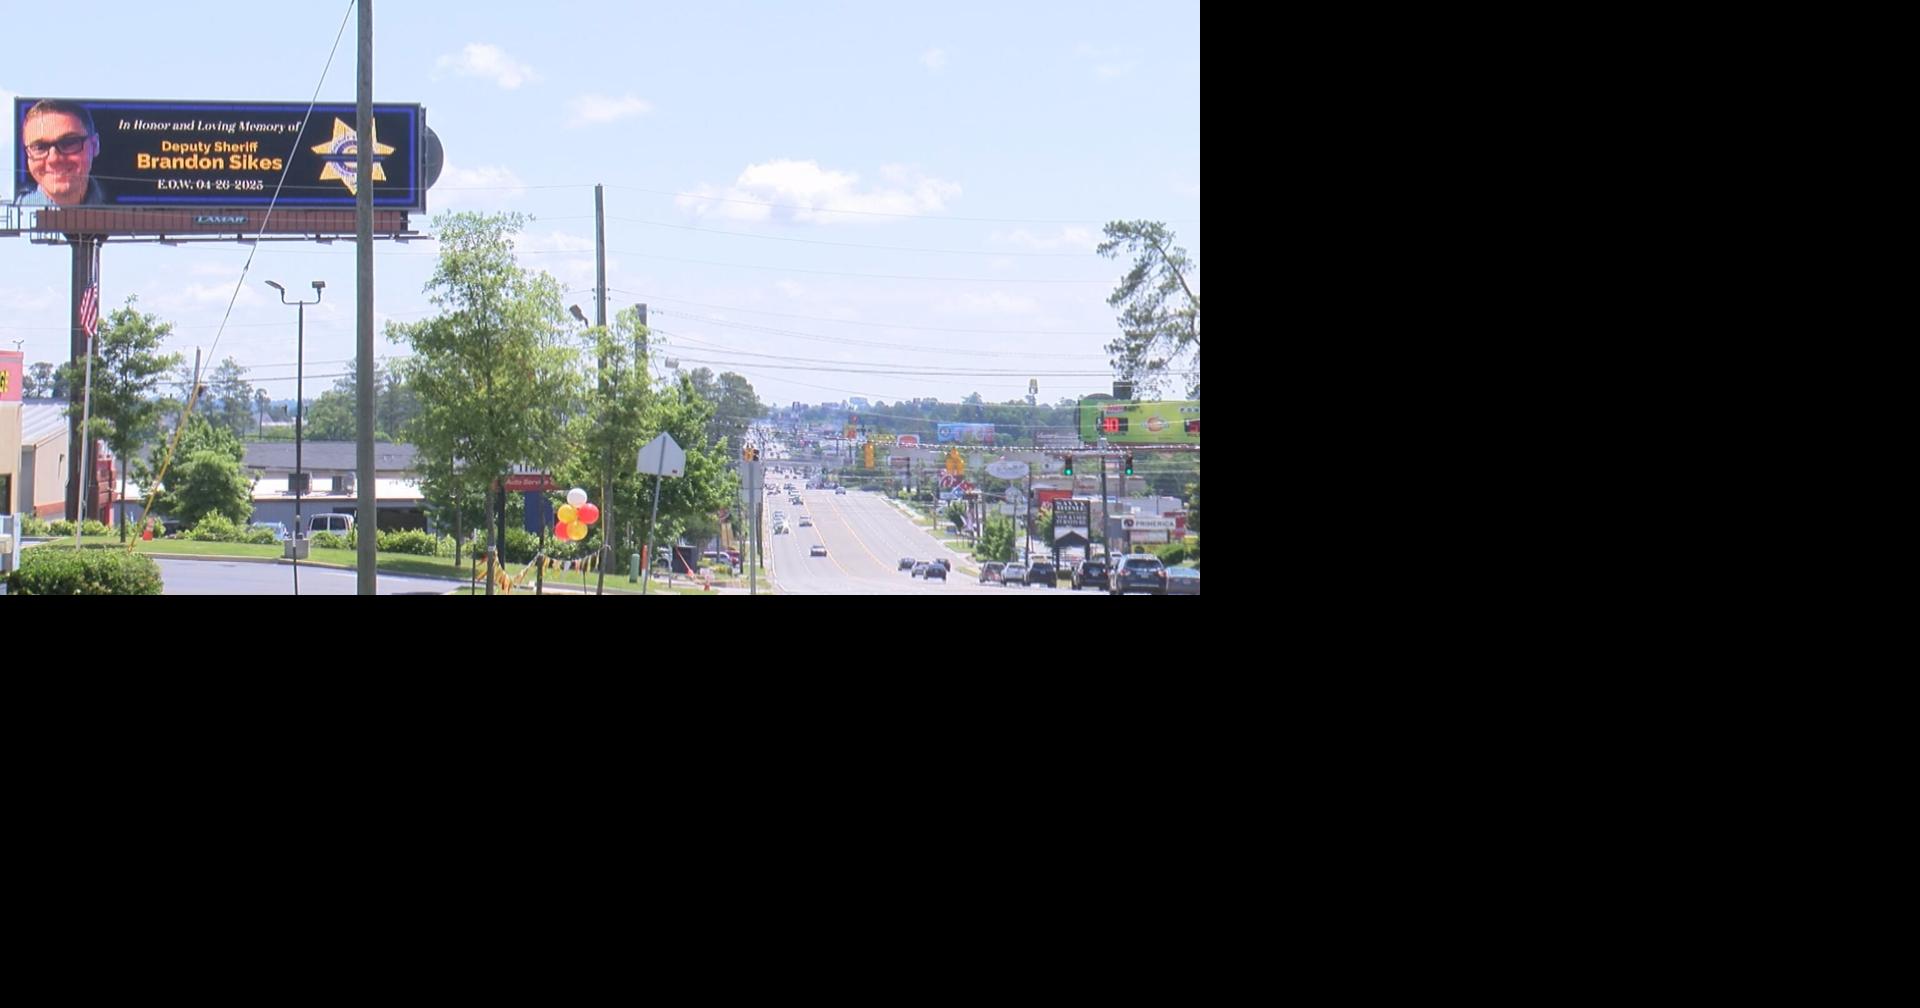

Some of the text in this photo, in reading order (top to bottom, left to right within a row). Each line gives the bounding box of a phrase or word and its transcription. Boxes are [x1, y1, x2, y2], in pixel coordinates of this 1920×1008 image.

[118, 119, 302, 134] In Honor and Loving Memory of
[161, 140, 258, 155] Deputy Sheriff
[136, 153, 283, 171] Brandon Sikes
[157, 179, 193, 190] E.O.W.
